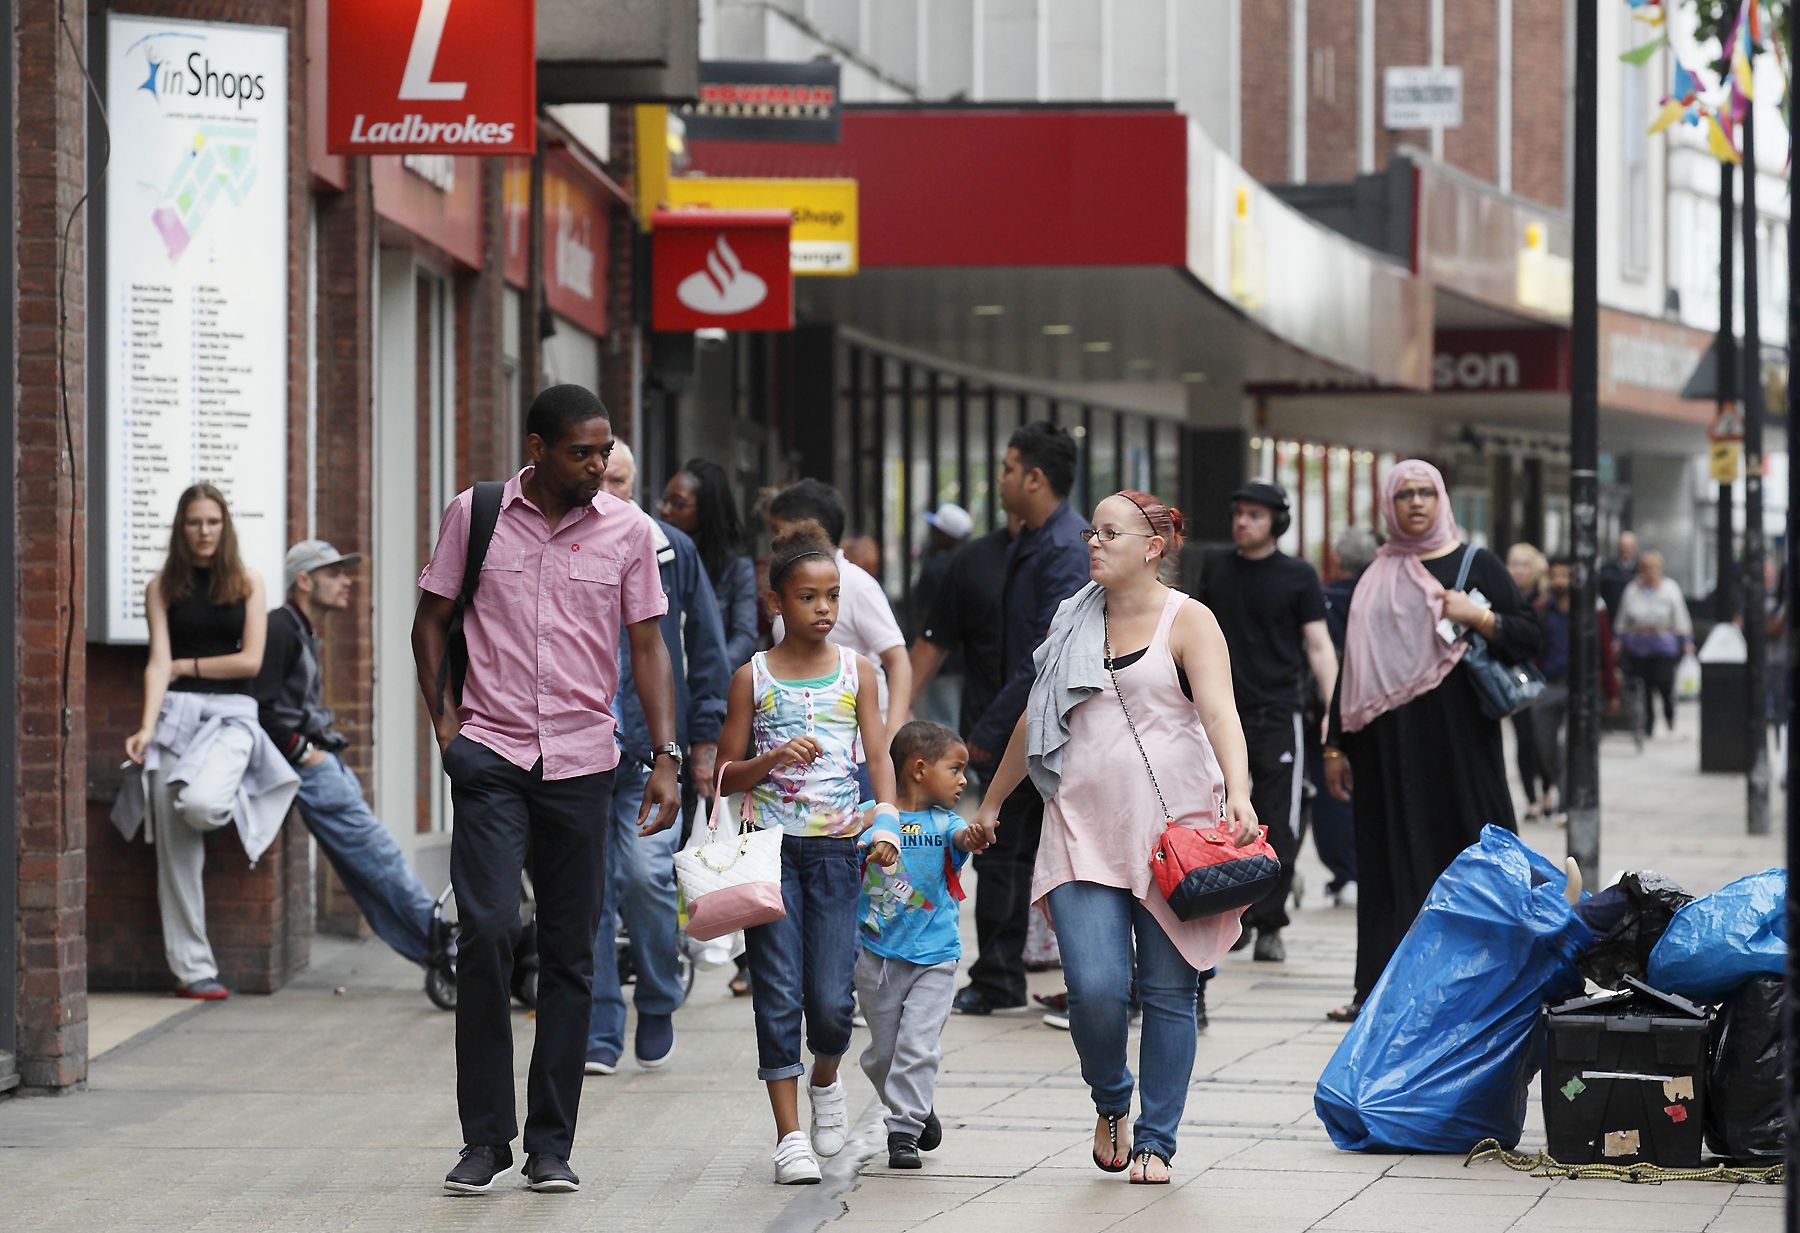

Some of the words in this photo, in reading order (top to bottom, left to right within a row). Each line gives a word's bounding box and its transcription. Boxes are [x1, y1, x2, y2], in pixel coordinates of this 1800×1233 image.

[700, 85, 834, 105] HOWMAN
[350, 112, 516, 144] Ladbrokes
[793, 208, 845, 231] Shop
[1434, 353, 1519, 387] son
[901, 823, 921, 835] AR
[901, 834, 943, 847] INING
